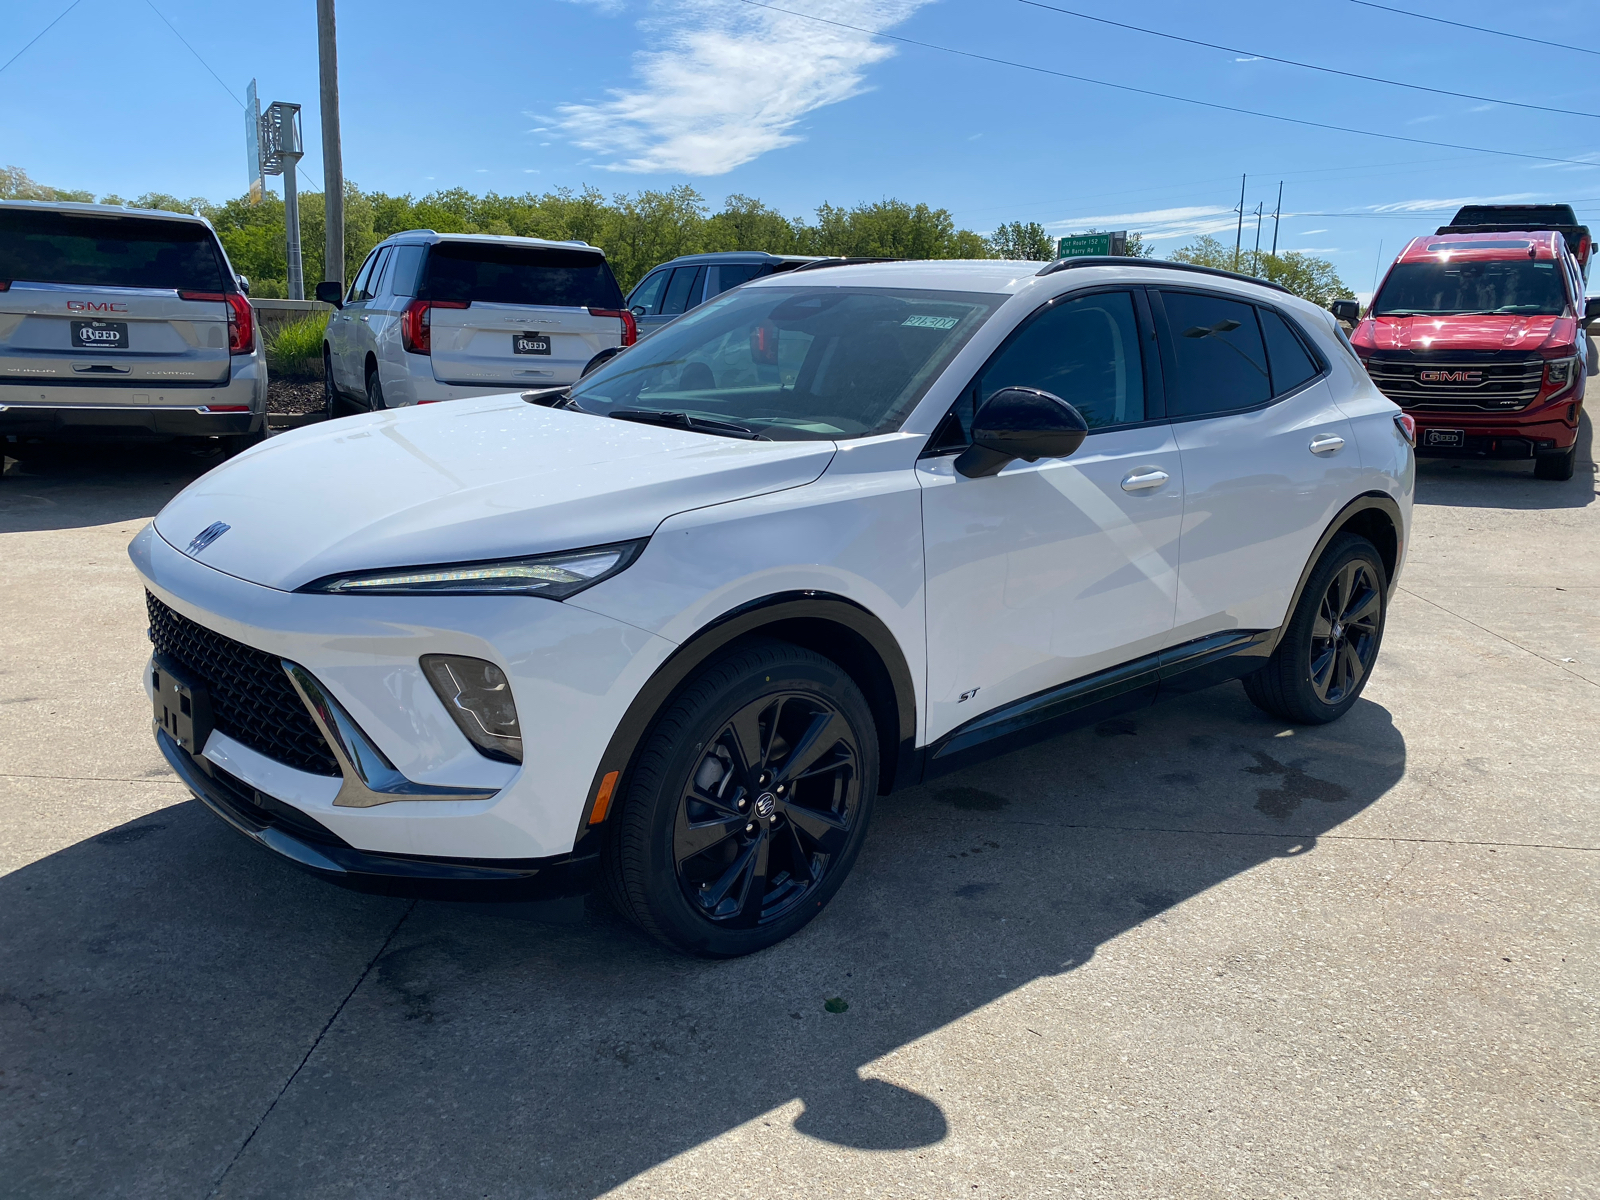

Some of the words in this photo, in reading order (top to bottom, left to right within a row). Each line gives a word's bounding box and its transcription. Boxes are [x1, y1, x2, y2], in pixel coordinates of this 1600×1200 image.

[67, 300, 128, 313] GMC
[80, 327, 120, 342] REED
[518, 339, 547, 351] REED
[1421, 371, 1482, 381] GMC
[1429, 432, 1459, 443] REED
[957, 686, 981, 704] ST
